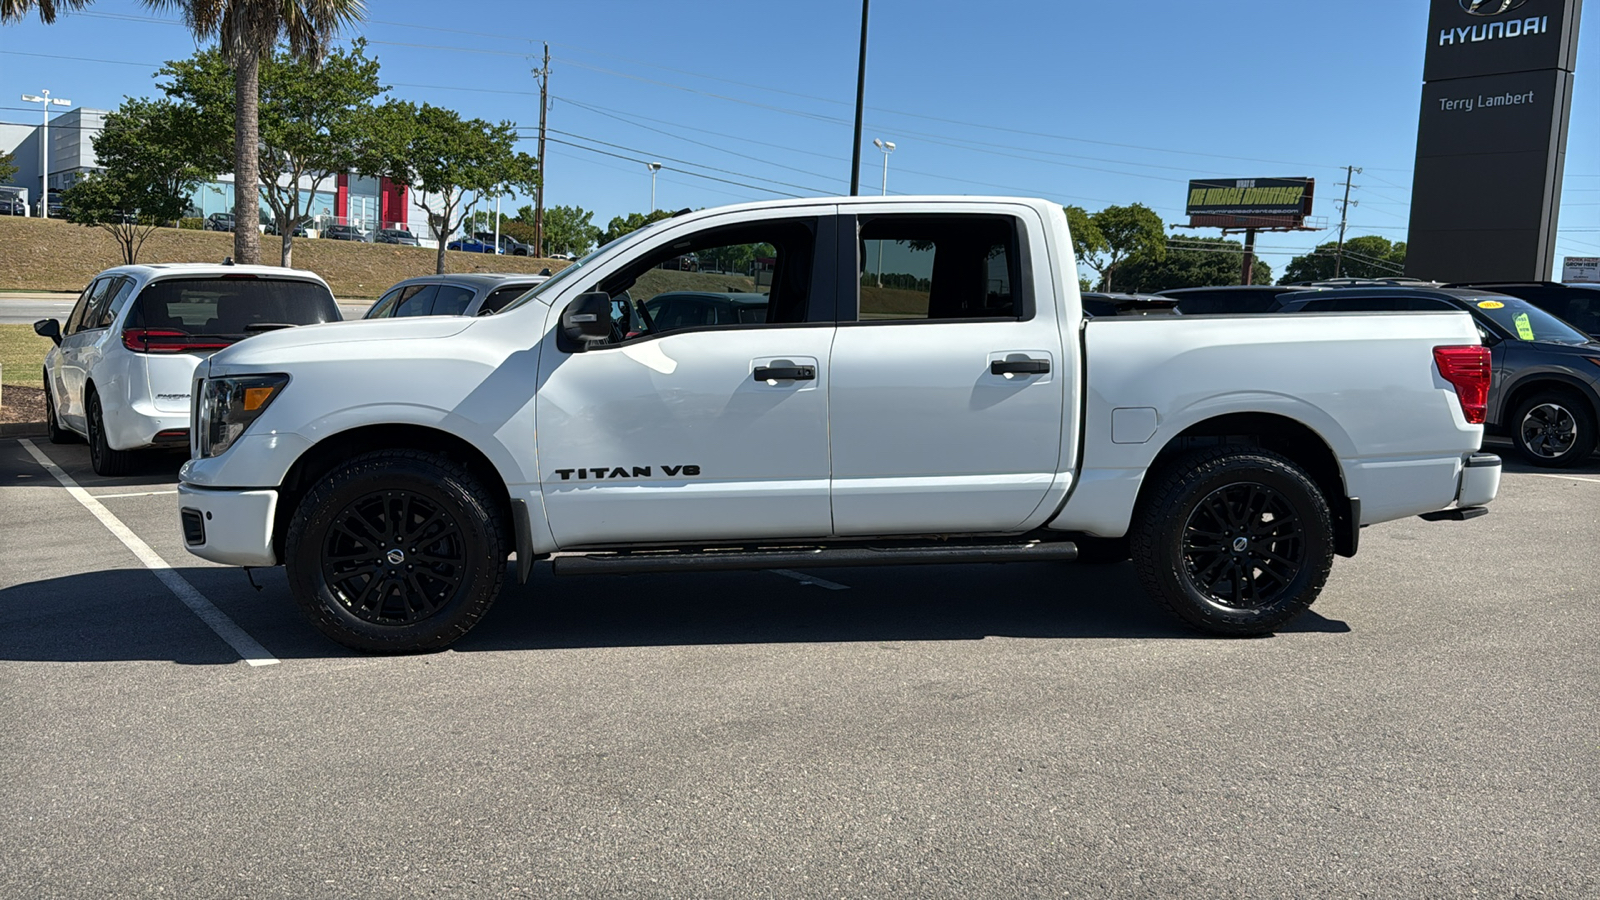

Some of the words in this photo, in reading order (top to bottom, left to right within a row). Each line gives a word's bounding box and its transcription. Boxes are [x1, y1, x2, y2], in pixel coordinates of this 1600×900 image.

[1439, 15, 1548, 46] HYUNDAI
[1439, 97, 1474, 112] Terry
[1477, 90, 1534, 108] Lambert
[1188, 188, 1207, 206] THE
[1203, 187, 1245, 205] MIRACLE
[1241, 186, 1304, 205] ADVANTAGE?
[555, 466, 652, 480] TITAN
[660, 465, 701, 477] V8
